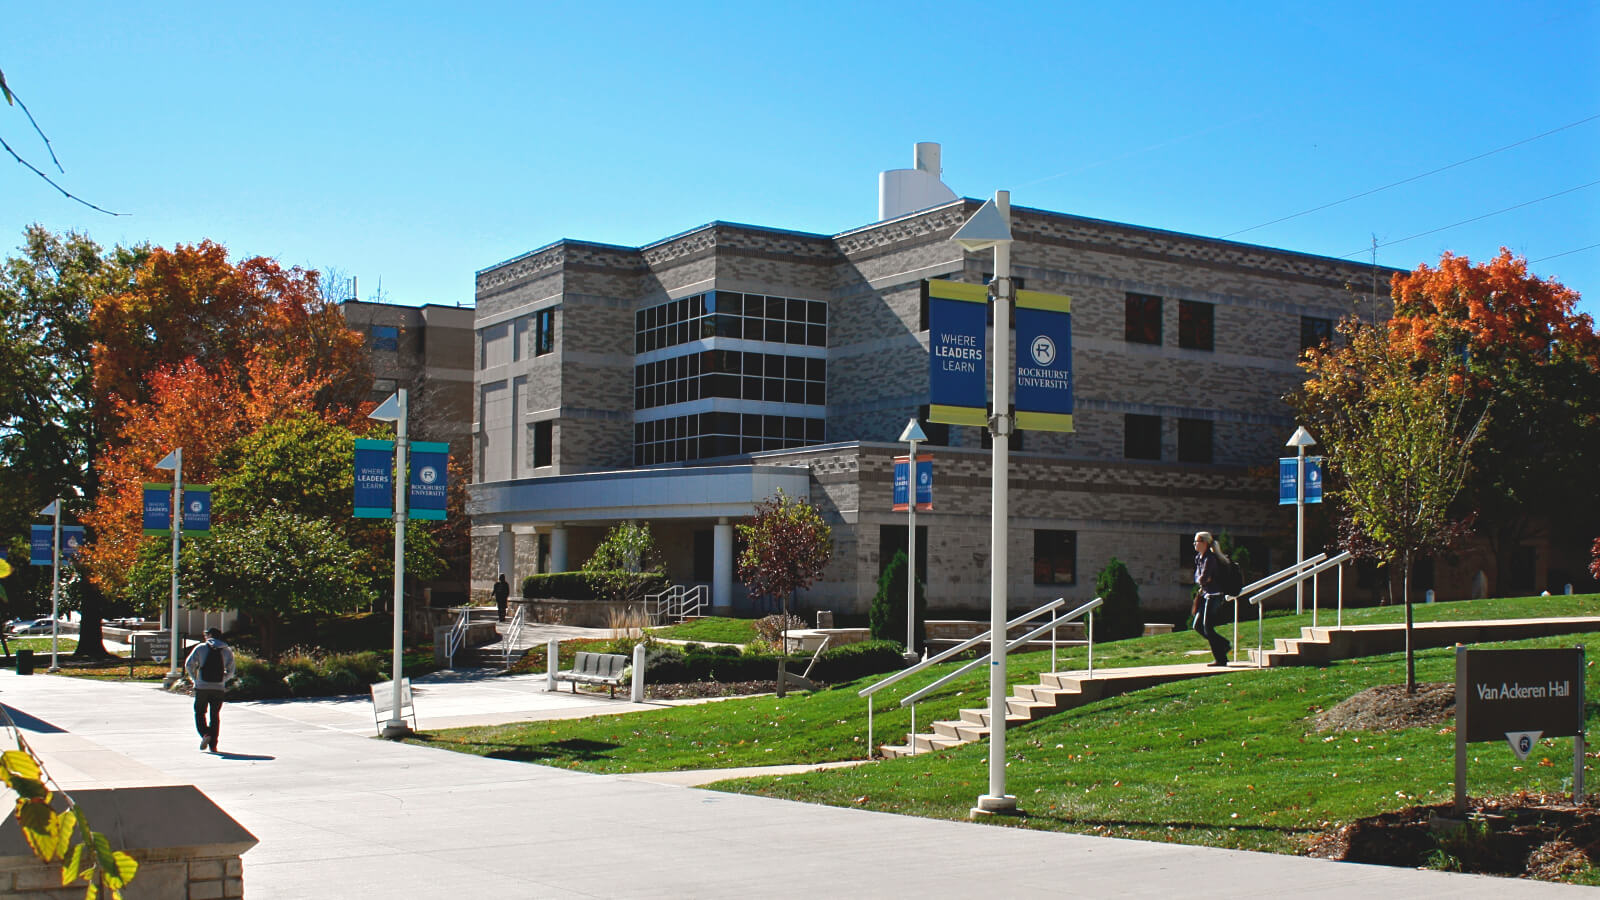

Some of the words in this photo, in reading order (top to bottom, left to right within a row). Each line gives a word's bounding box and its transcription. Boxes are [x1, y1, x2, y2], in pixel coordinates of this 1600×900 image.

[941, 333, 976, 347] WHERE
[935, 345, 983, 361] LEADERS
[942, 360, 975, 373] LEARN
[1018, 367, 1069, 380] ROCKHURST
[1018, 377, 1069, 390] UNIVERSITY
[357, 475, 389, 483] LEADERS
[1477, 683, 1498, 700] Van
[1500, 682, 1546, 699] Ackeren
[1549, 680, 1570, 697] Hall
